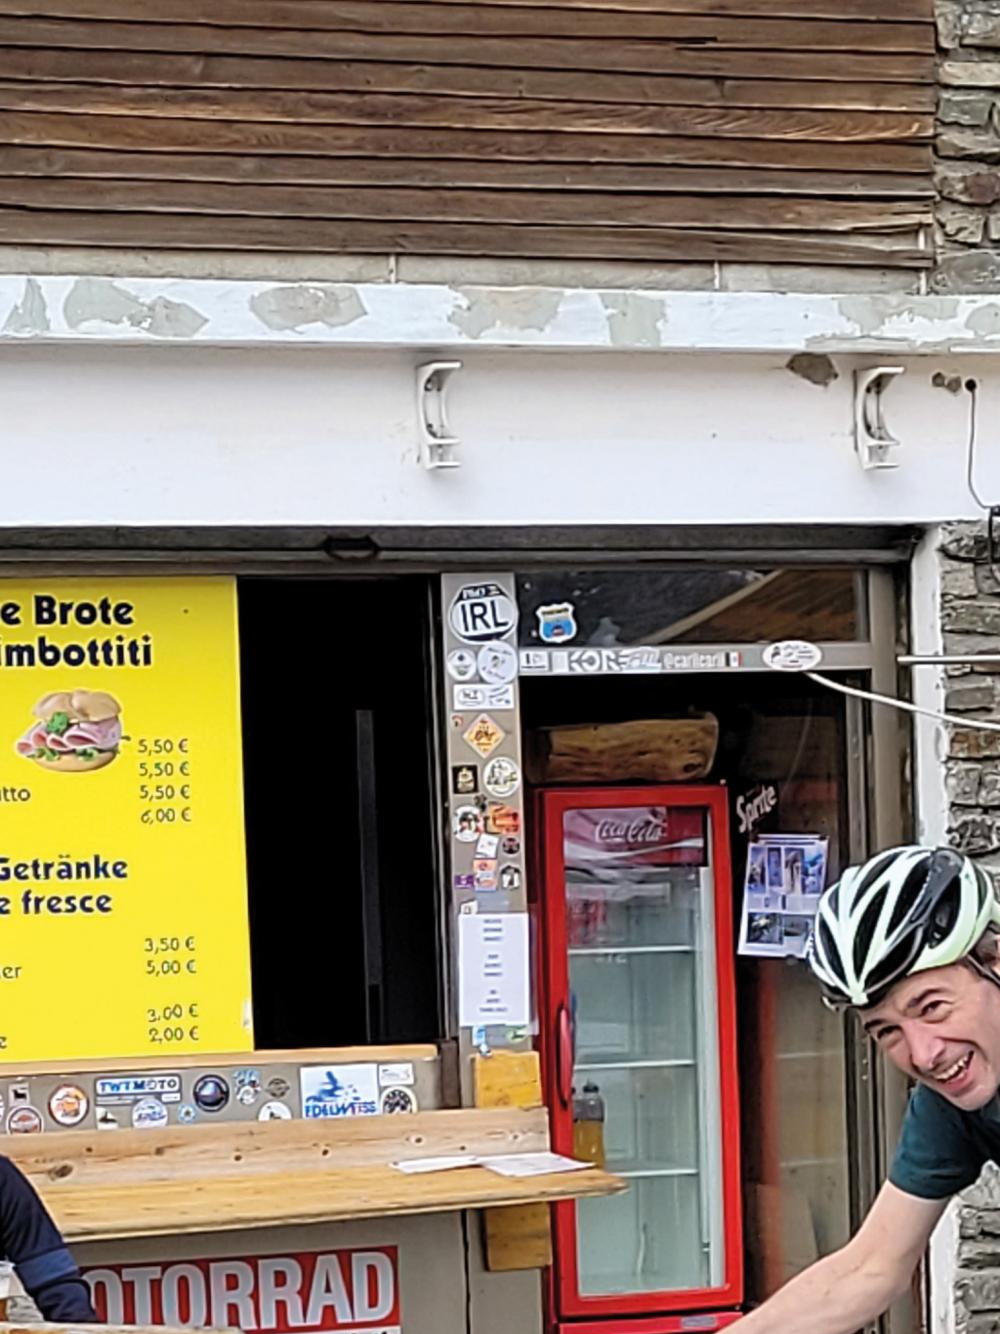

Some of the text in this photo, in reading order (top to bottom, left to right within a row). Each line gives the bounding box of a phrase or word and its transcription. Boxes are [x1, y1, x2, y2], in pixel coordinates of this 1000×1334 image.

[34, 595, 135, 627] Brote
[461, 600, 509, 632] IRL
[0, 634, 153, 668] mbottiti
[137, 738, 189, 756] 5,50 €
[139, 761, 190, 778] 5,50 €
[0, 787, 31, 802] tto
[139, 784, 190, 801] 5,50 €
[181, 807, 192, 822] €
[736, 785, 778, 833] Sprite
[22, 890, 113, 915] fresce
[144, 936, 195, 954] 3,50 €
[146, 959, 197, 976] 5,00 €
[189, 1003, 199, 1018] €
[189, 1026, 199, 1041] €
